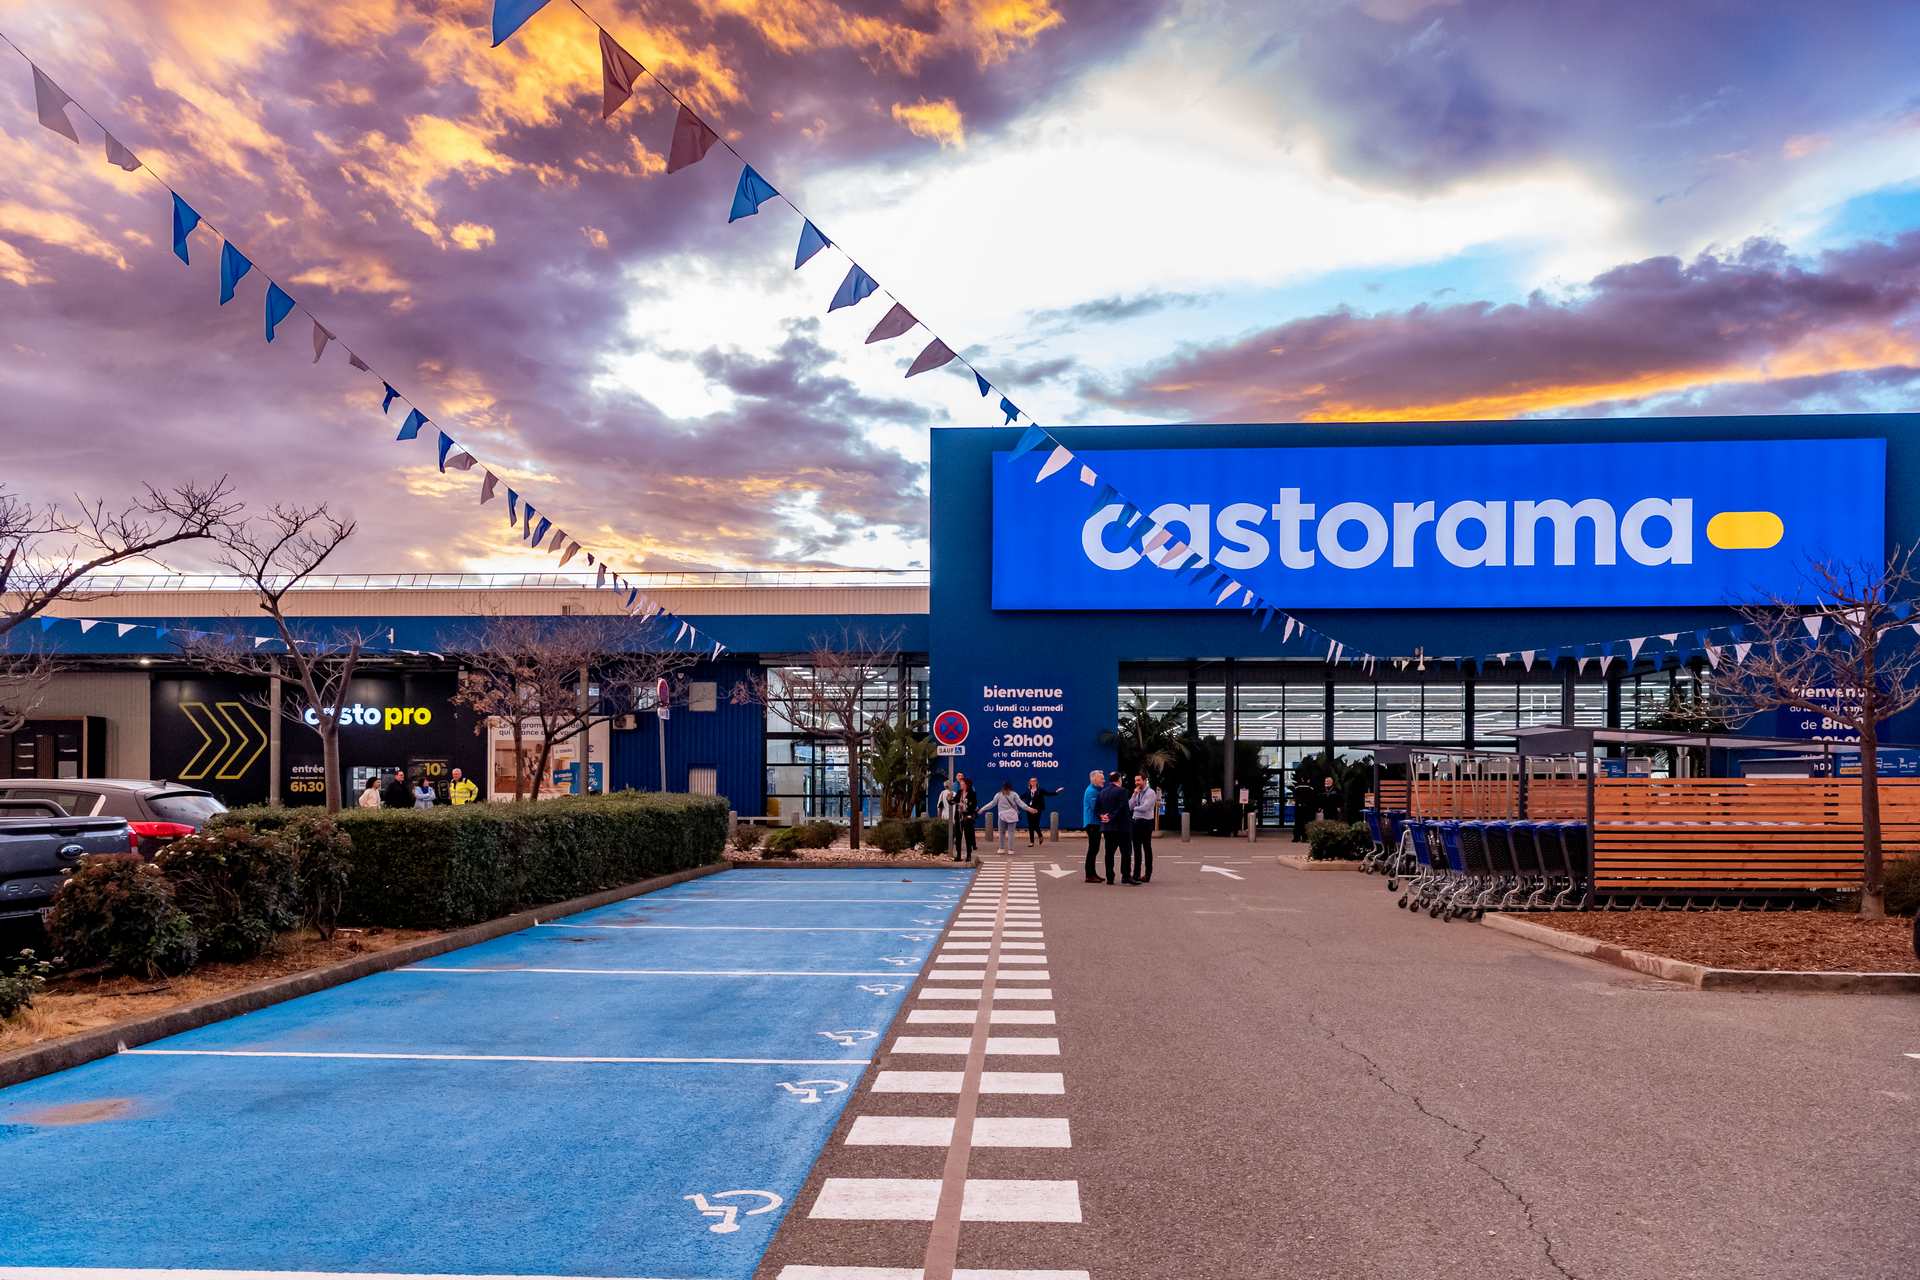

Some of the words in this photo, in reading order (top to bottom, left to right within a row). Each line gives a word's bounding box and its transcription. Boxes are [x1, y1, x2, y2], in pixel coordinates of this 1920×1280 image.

[1082, 487, 1693, 571] castorama
[983, 685, 1063, 698] bienvenue
[983, 704, 995, 712] du
[996, 704, 1018, 712] lundi
[1031, 704, 1064, 712] samedi
[384, 707, 432, 731] pro
[993, 719, 1009, 729] de
[1012, 716, 1053, 729] 8h00
[1800, 719, 1818, 730] de
[992, 737, 1001, 747] à
[1003, 734, 1054, 747] 20h00
[1010, 750, 1053, 758] dimanche
[292, 765, 325, 774] entrée
[998, 760, 1022, 768] 9h00
[1031, 760, 1059, 768] 18h00
[290, 781, 325, 792] 6h30
